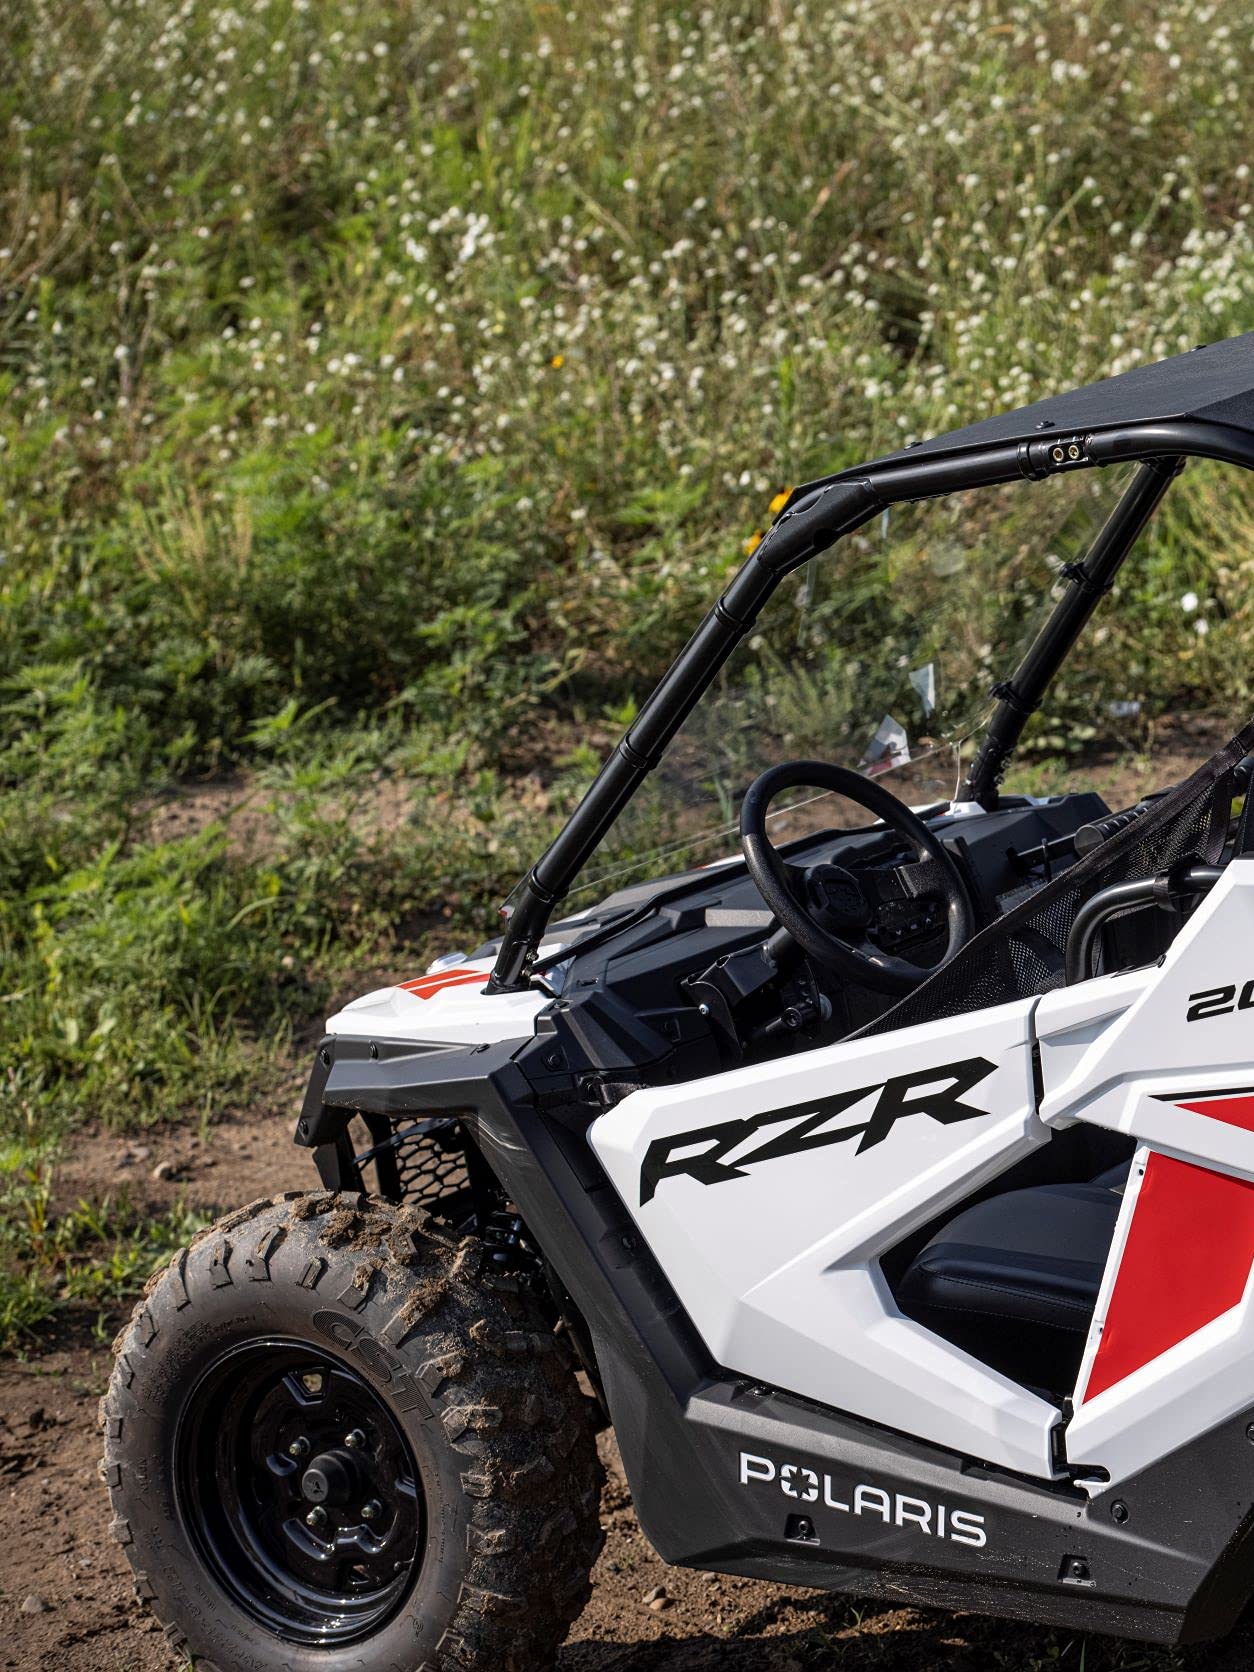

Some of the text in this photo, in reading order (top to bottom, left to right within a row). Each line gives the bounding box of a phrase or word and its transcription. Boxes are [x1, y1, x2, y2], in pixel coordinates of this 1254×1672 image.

[639, 1056, 999, 1207] RZR
[312, 1309, 435, 1421] CST
[739, 1452, 987, 1547] POLARIS
